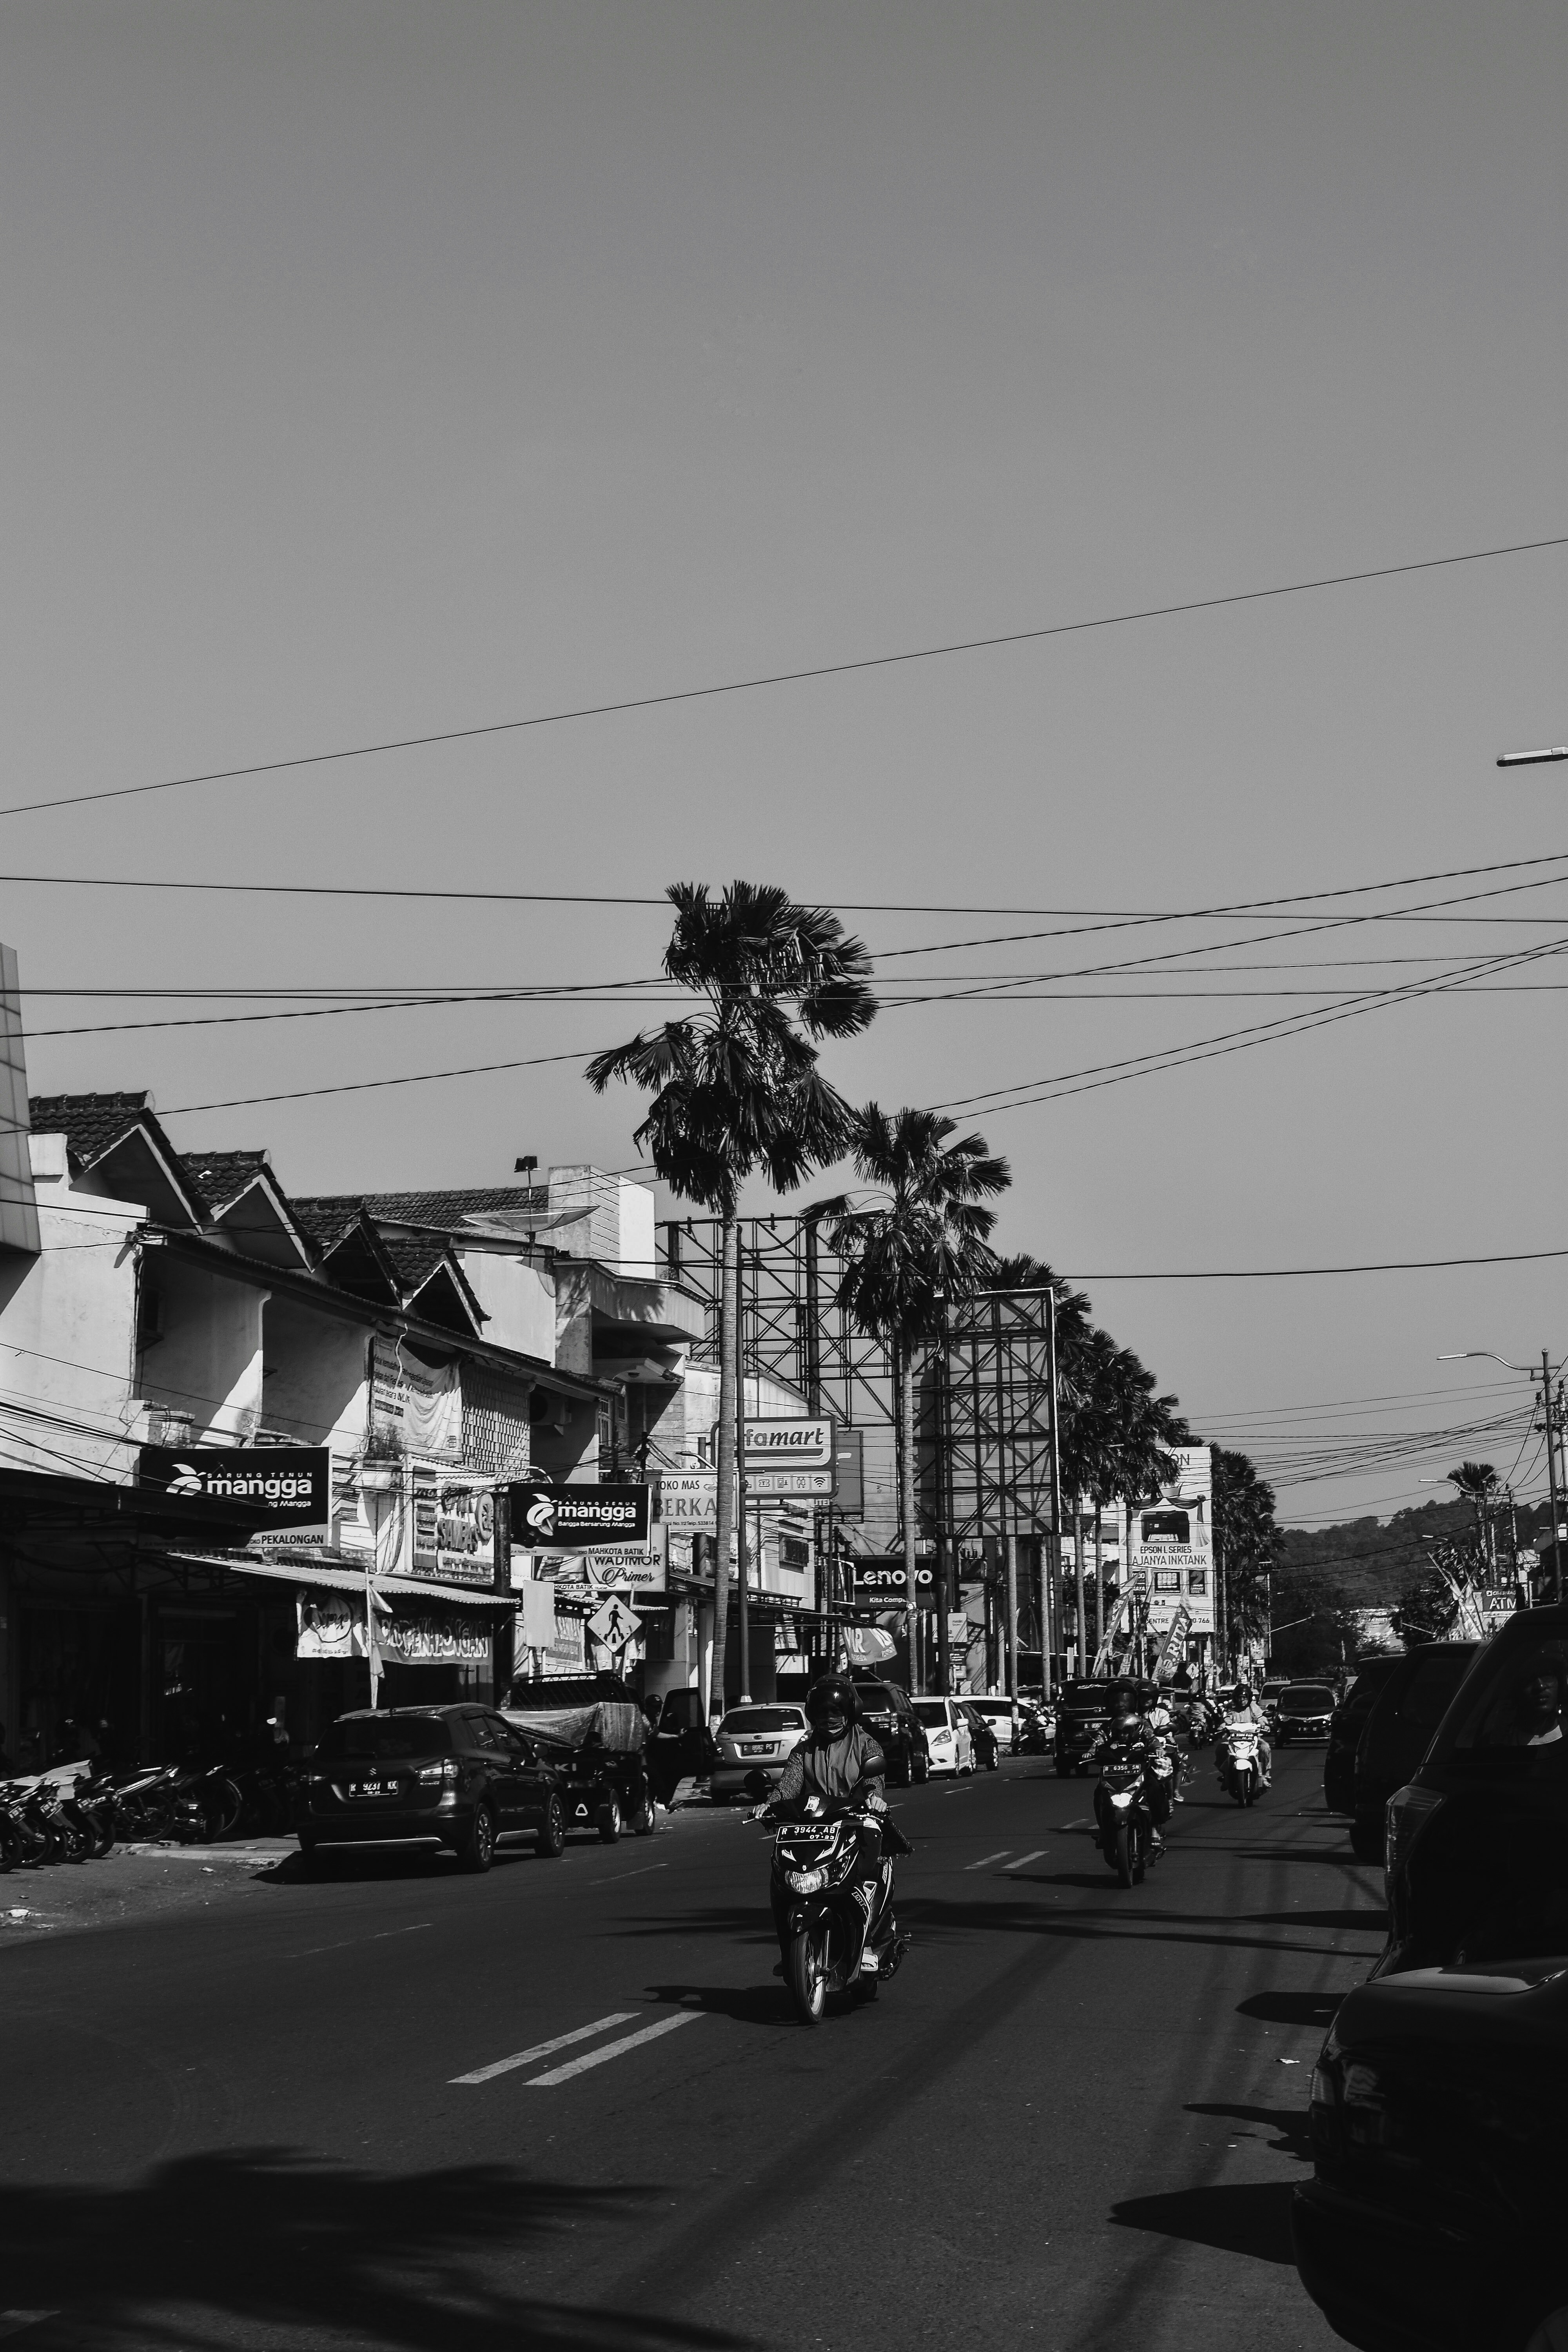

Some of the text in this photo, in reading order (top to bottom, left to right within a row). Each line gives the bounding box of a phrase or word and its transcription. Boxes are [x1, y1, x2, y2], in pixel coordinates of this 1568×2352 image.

[744, 1428, 824, 1446] famart
[207, 1479, 312, 1499] mangga
[655, 1480, 699, 1490] TOKO MAS
[557, 1506, 636, 1521] mangga
[653, 1497, 717, 1516] BERKA
[261, 1535, 323, 1544] PEKALONGAN
[595, 1555, 661, 1566] WADIMOR
[1132, 1555, 1207, 1565] AJANYA INKTANK
[602, 1567, 655, 1587] Primer
